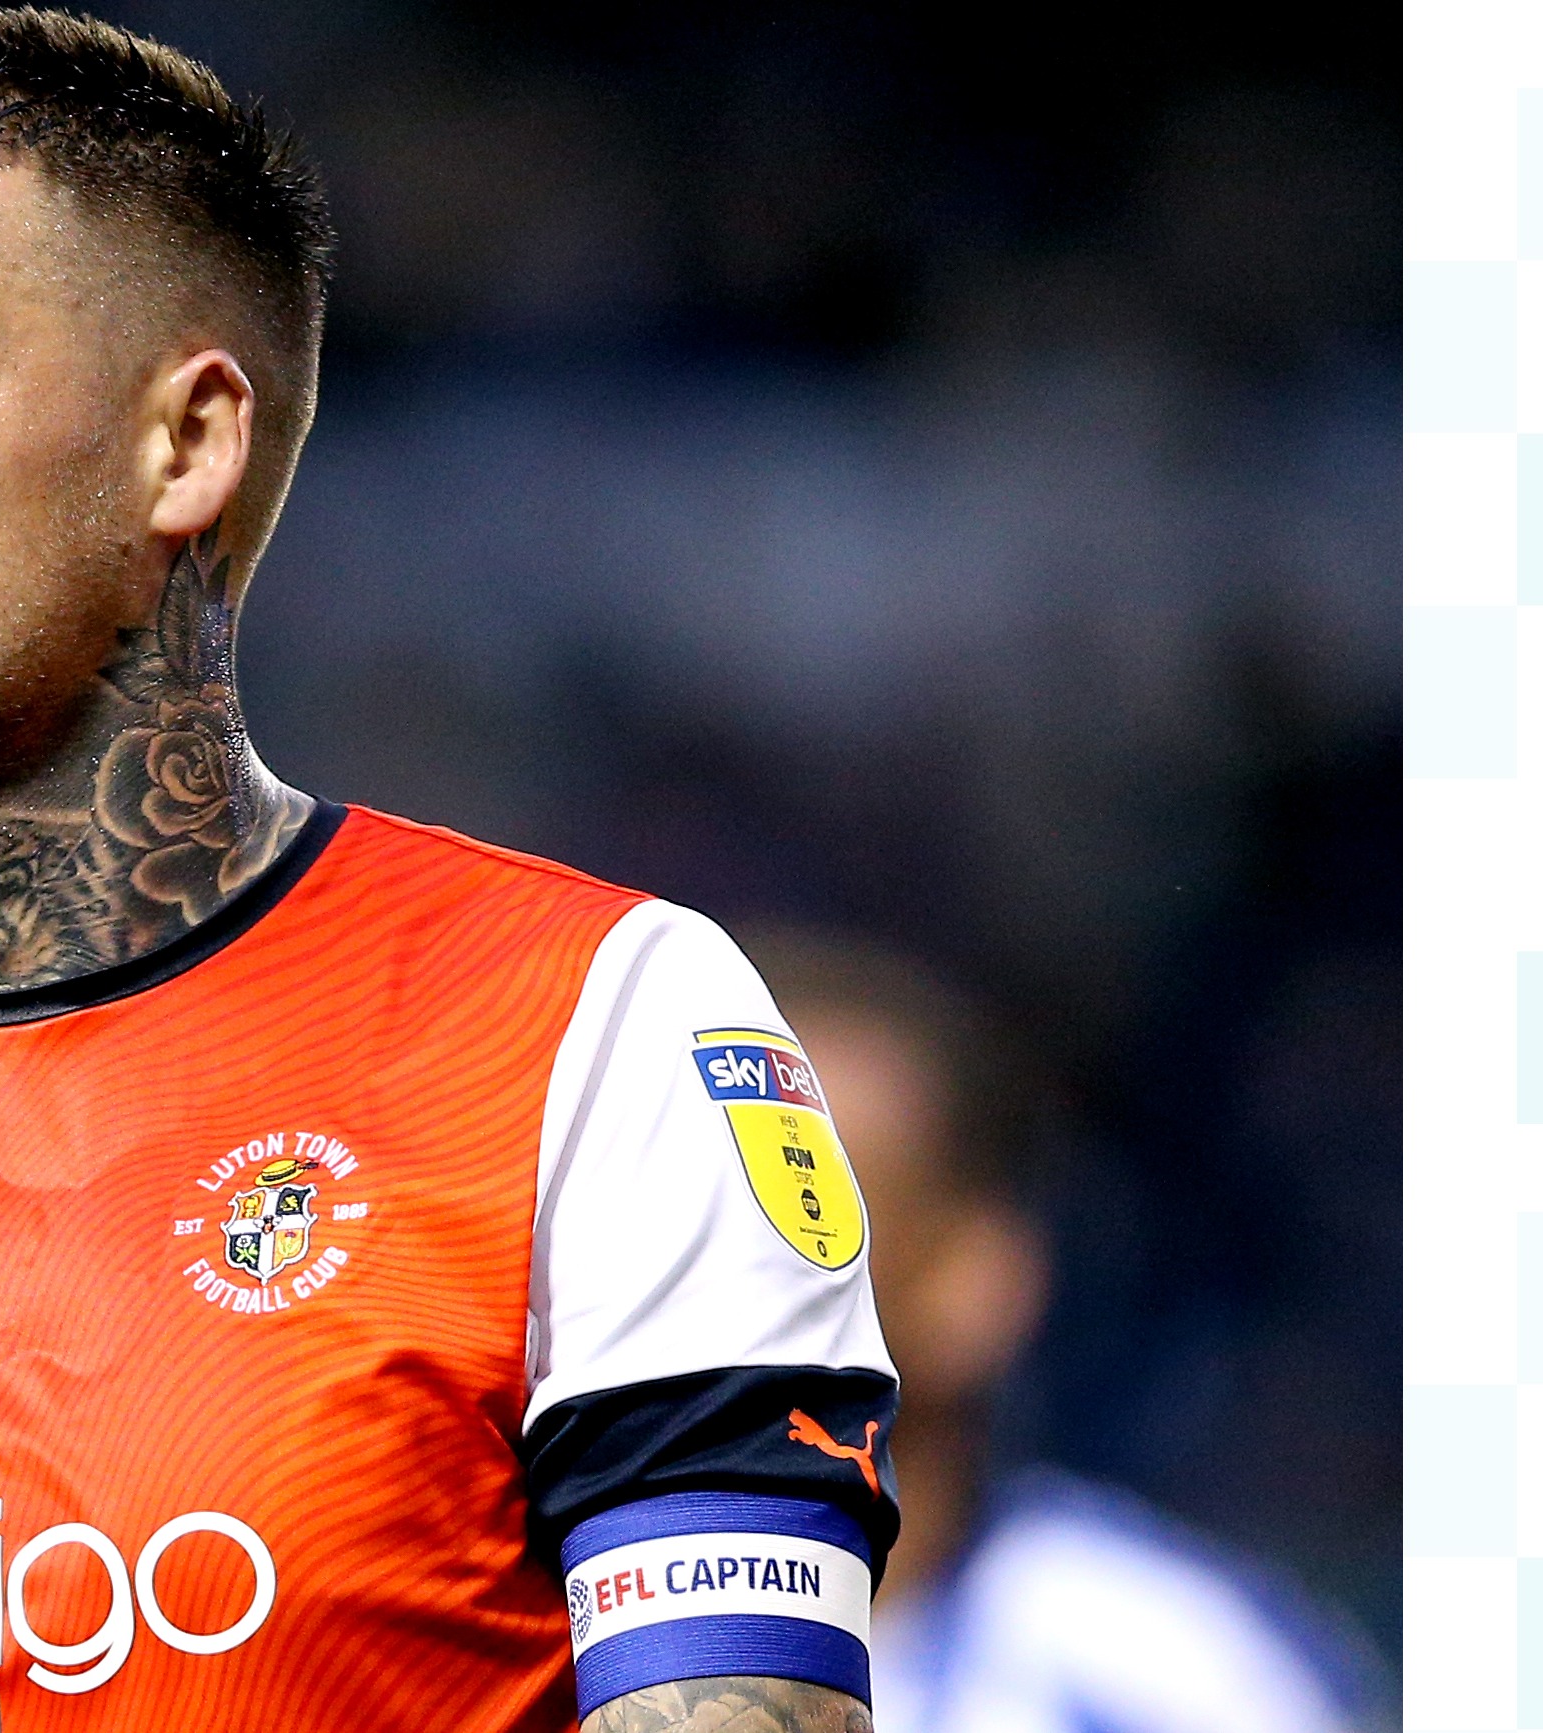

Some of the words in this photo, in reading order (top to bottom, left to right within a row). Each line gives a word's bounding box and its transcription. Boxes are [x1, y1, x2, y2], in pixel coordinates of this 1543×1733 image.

[707, 1049, 767, 1096] sky
[770, 1052, 819, 1101] bet
[196, 1132, 285, 1192] LUTON
[294, 1131, 359, 1180] TOWN
[782, 1145, 816, 1170] FUN
[173, 1218, 205, 1236] EST
[332, 1202, 368, 1221] 1885
[182, 1258, 291, 1314] FOOTBALL
[291, 1246, 349, 1299] CLUB
[594, 1567, 655, 1614] EFL
[665, 1557, 821, 1598] CAPTAIN
